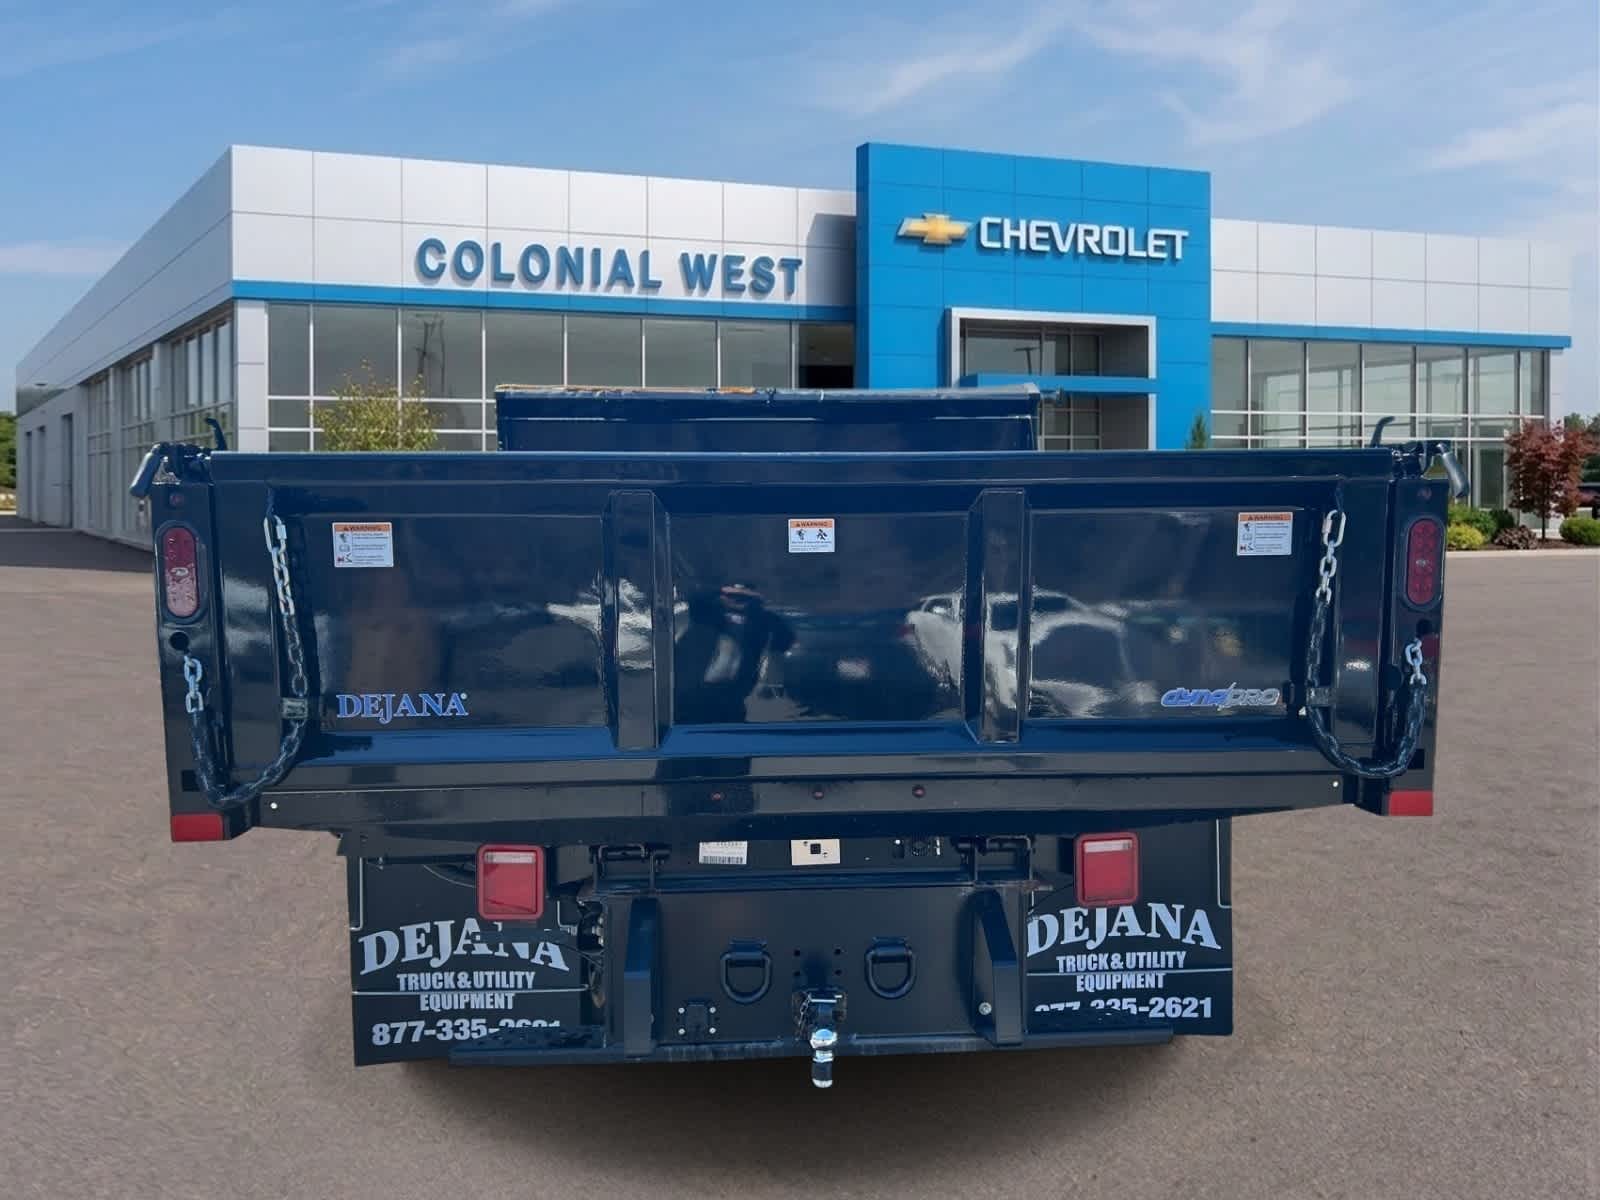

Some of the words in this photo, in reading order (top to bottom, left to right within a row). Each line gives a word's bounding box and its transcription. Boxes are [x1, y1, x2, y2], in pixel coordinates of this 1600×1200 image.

[980, 216, 1189, 260] CHEVROLET
[416, 238, 662, 289] COLONIAL
[680, 252, 803, 296] WEST
[1027, 903, 1221, 957] DEJANA
[420, 992, 515, 1012] EQUIPMENT
[1076, 972, 1166, 993] EQUIPMENT
